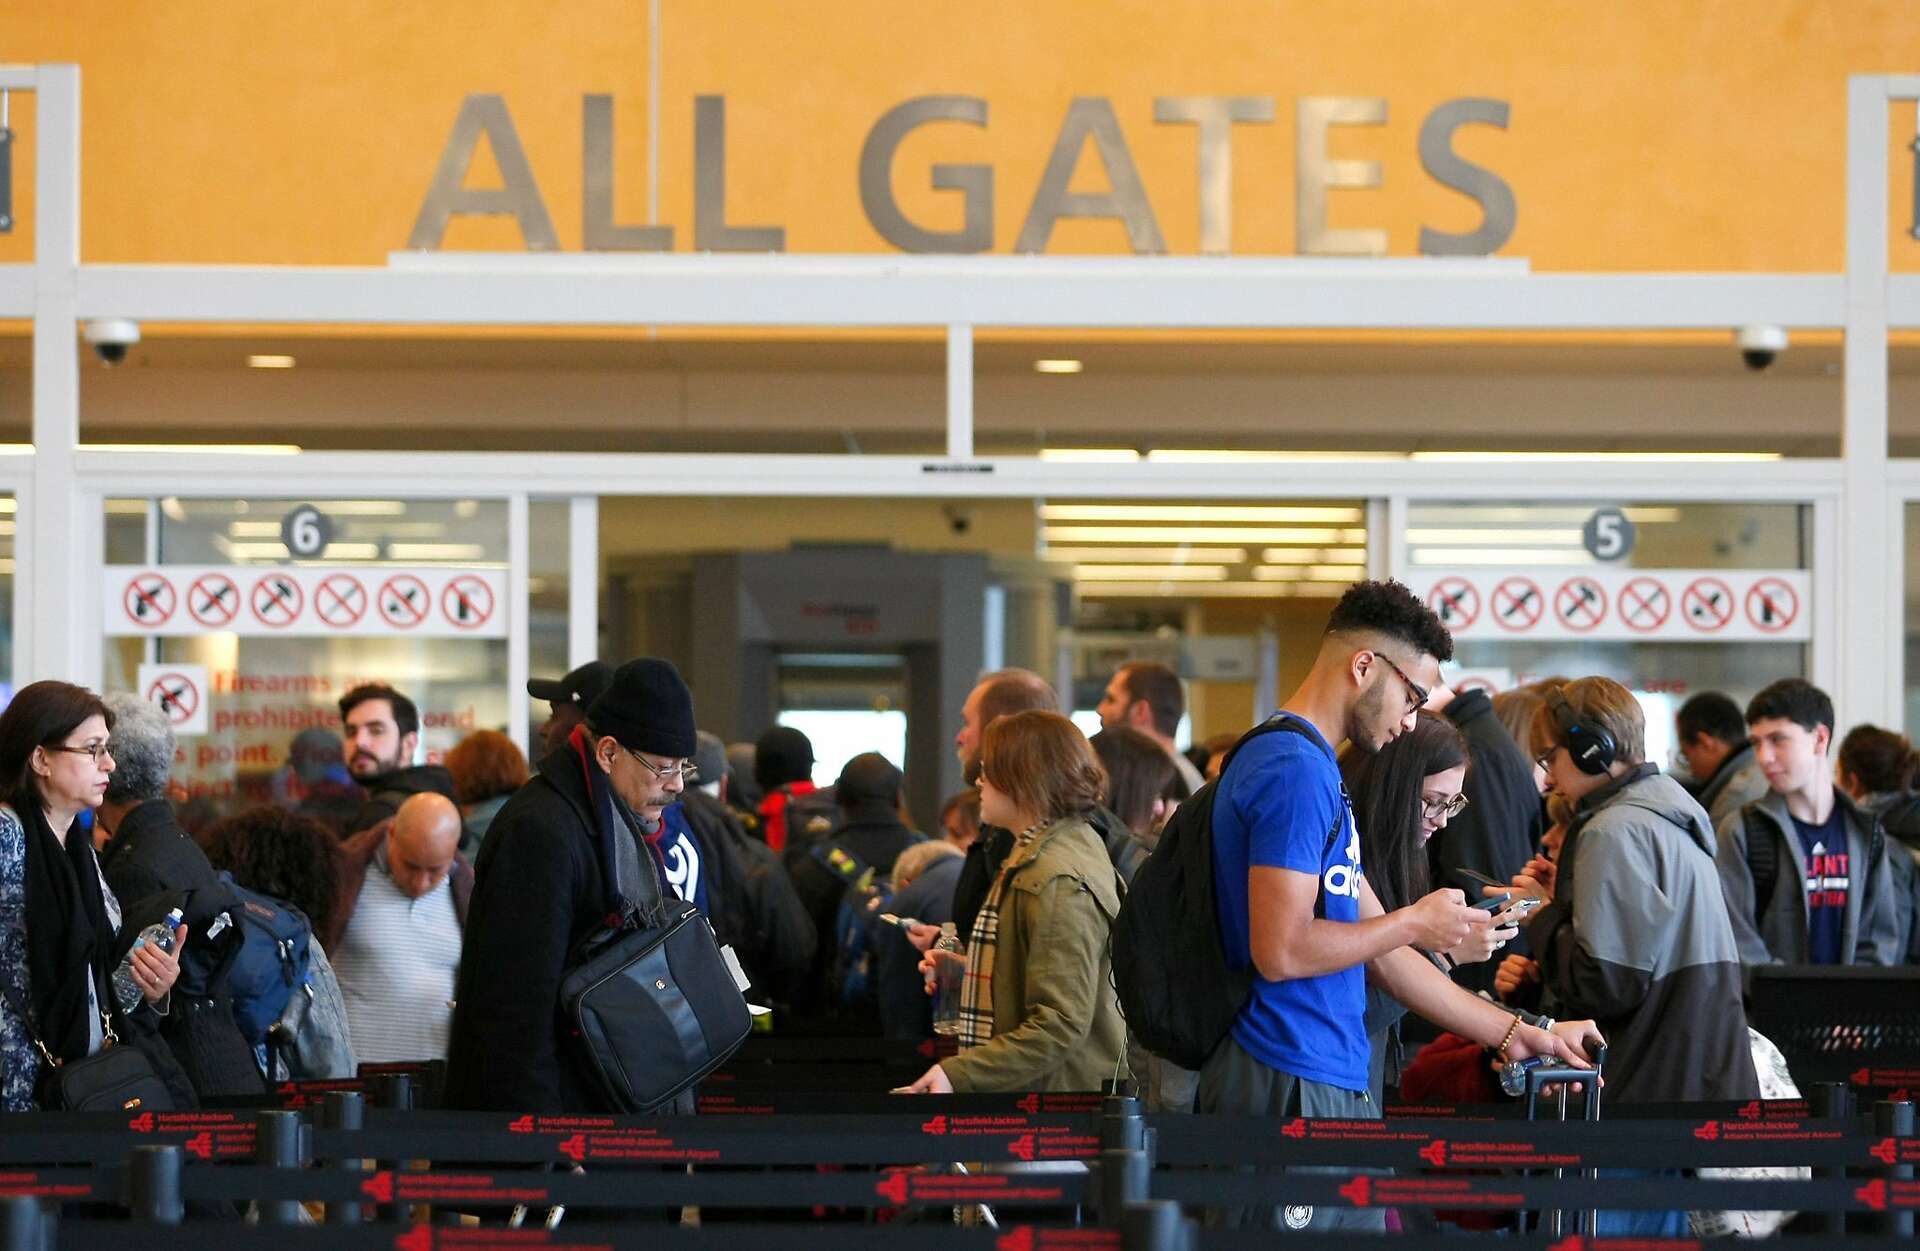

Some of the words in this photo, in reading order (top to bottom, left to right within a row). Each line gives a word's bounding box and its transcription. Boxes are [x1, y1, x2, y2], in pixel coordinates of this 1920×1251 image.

[406, 93, 785, 253] ALL
[858, 95, 1519, 257] GATES
[293, 510, 321, 553] 6
[1596, 514, 1622, 557] 5
[214, 704, 342, 730] prohibite
[1804, 854, 1849, 876] LANT
